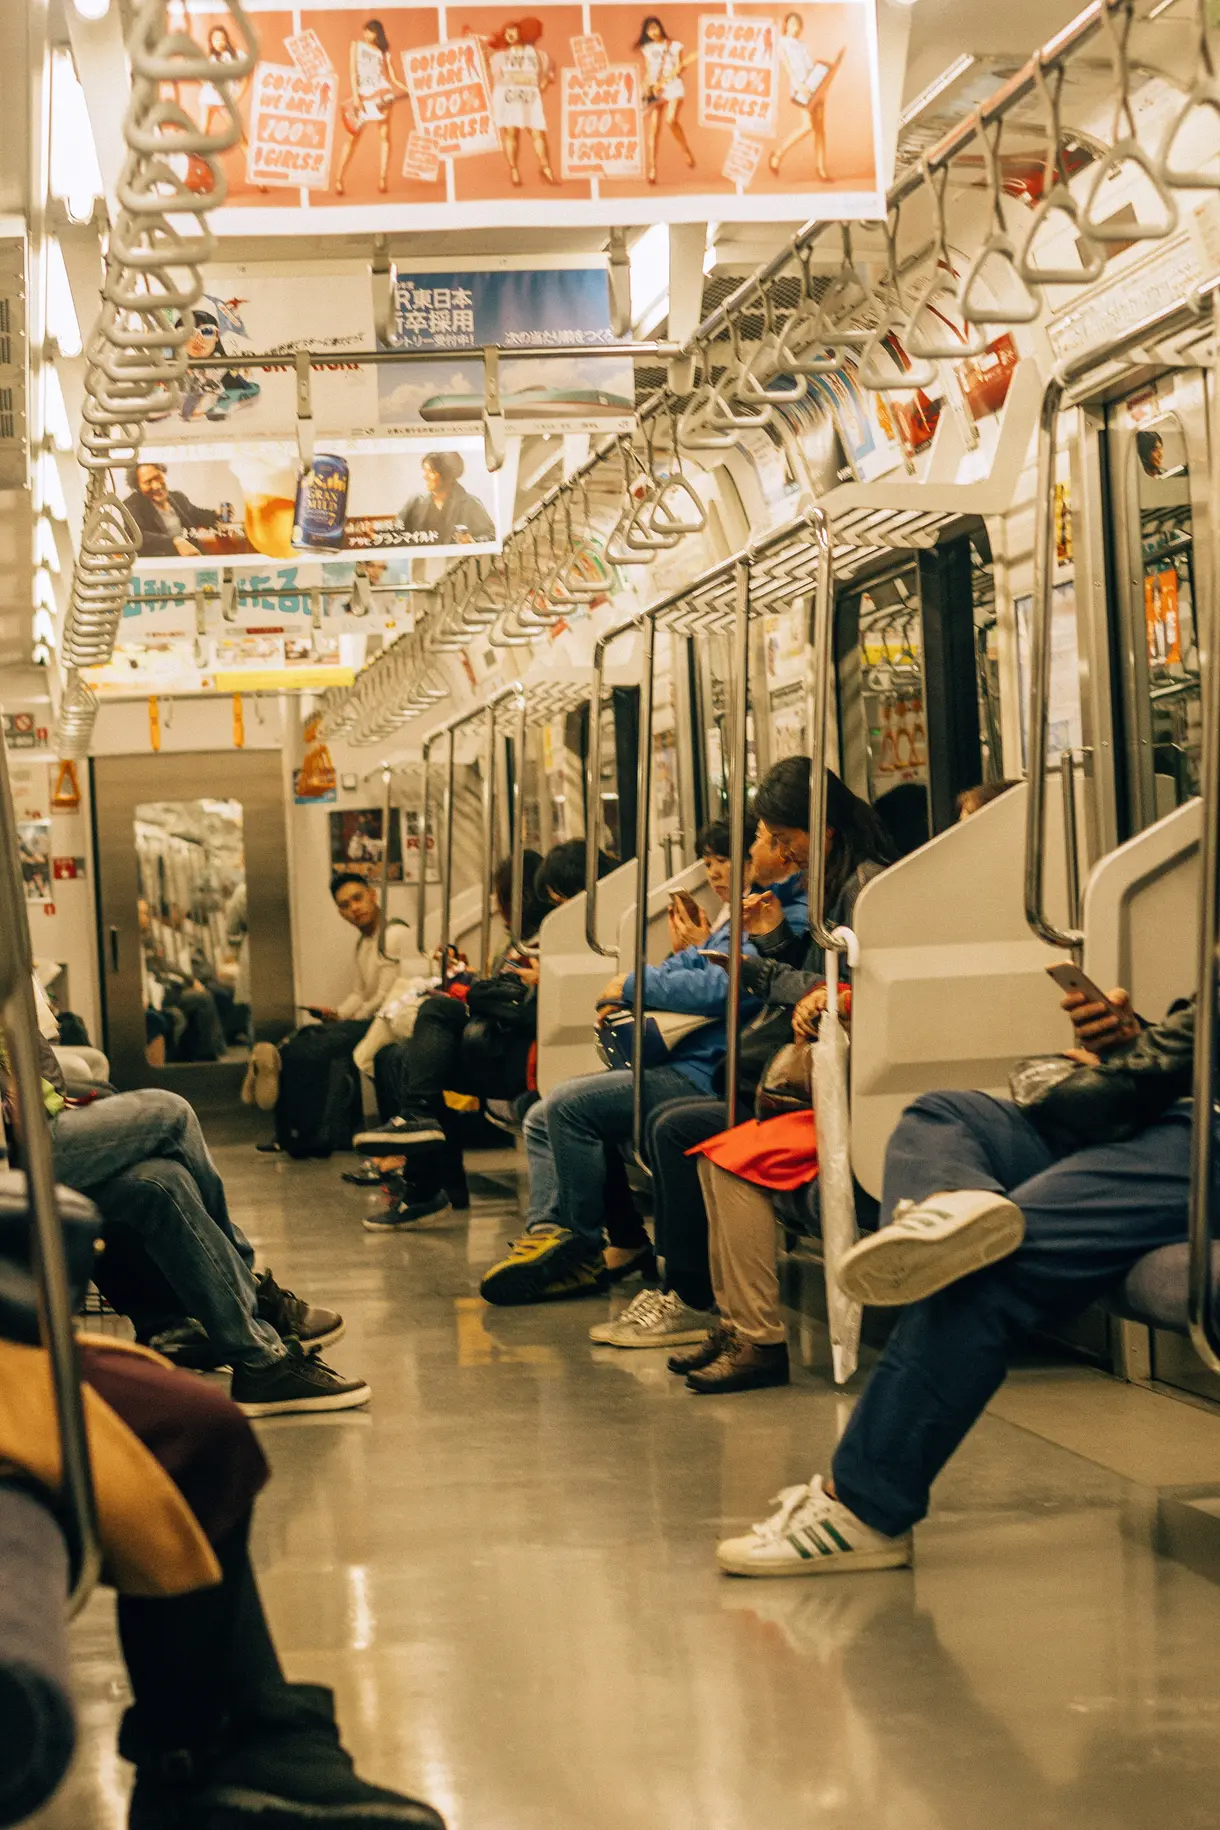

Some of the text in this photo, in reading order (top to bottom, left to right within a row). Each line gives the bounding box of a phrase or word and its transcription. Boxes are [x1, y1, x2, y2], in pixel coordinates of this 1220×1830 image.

[711, 67, 765, 92] 100%
[426, 89, 480, 119] 100%
[395, 288, 473, 310] R東日本
